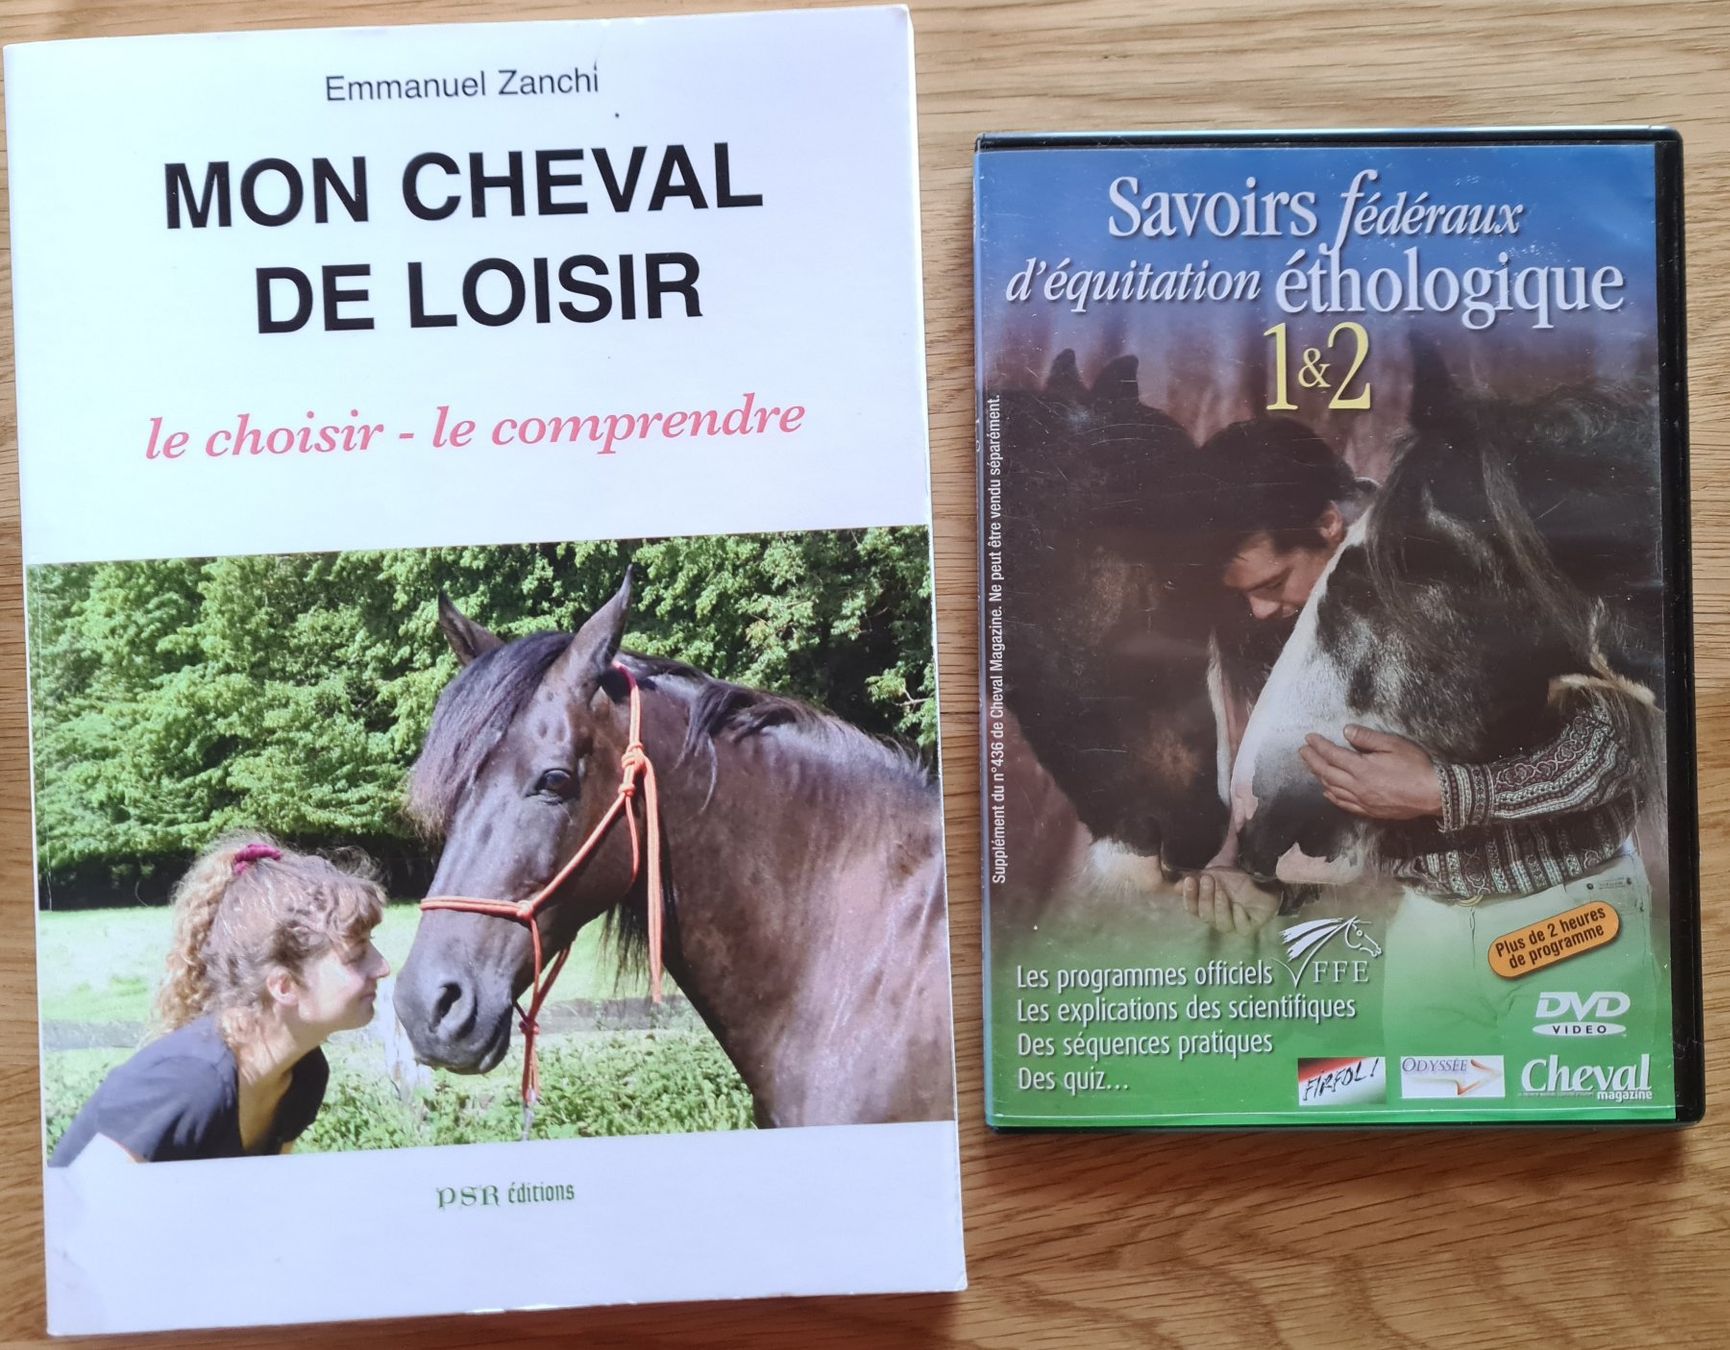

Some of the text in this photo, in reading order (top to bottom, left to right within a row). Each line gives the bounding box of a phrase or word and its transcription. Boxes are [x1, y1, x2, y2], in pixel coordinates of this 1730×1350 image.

[325, 62, 599, 102] Emmanuel Zanchi
[164, 142, 764, 230] MON CHEVAL
[1108, 169, 1524, 258] Savoirs fédéraux
[256, 251, 704, 335] DE LOISIR
[1006, 247, 1625, 331] d'équitation éthologique
[1262, 322, 1374, 412] 1&2
[145, 392, 806, 460] le choisir - le comprendre
[986, 395, 1008, 884] Supplément du n°436 de Cheval Magazine. Ne peut être vendu séparément.
[1495, 907, 1606, 957] Plus de 2 heures
[1509, 924, 1604, 969] de programme
[1016, 960, 1273, 993] Les programmes officiels
[1312, 961, 1370, 983] FFE
[1016, 989, 1357, 1025] Les explications des scientifiques
[1535, 991, 1632, 1021] DVD
[1017, 1030, 1273, 1061] Des séquences pratiques
[1552, 1024, 1607, 1035] VIDEO
[1018, 1066, 1130, 1099] Des quiz...
[1521, 1053, 1652, 1092] Cheval
[1597, 1090, 1653, 1103] magazine
[507, 1182, 576, 1204] éditions
